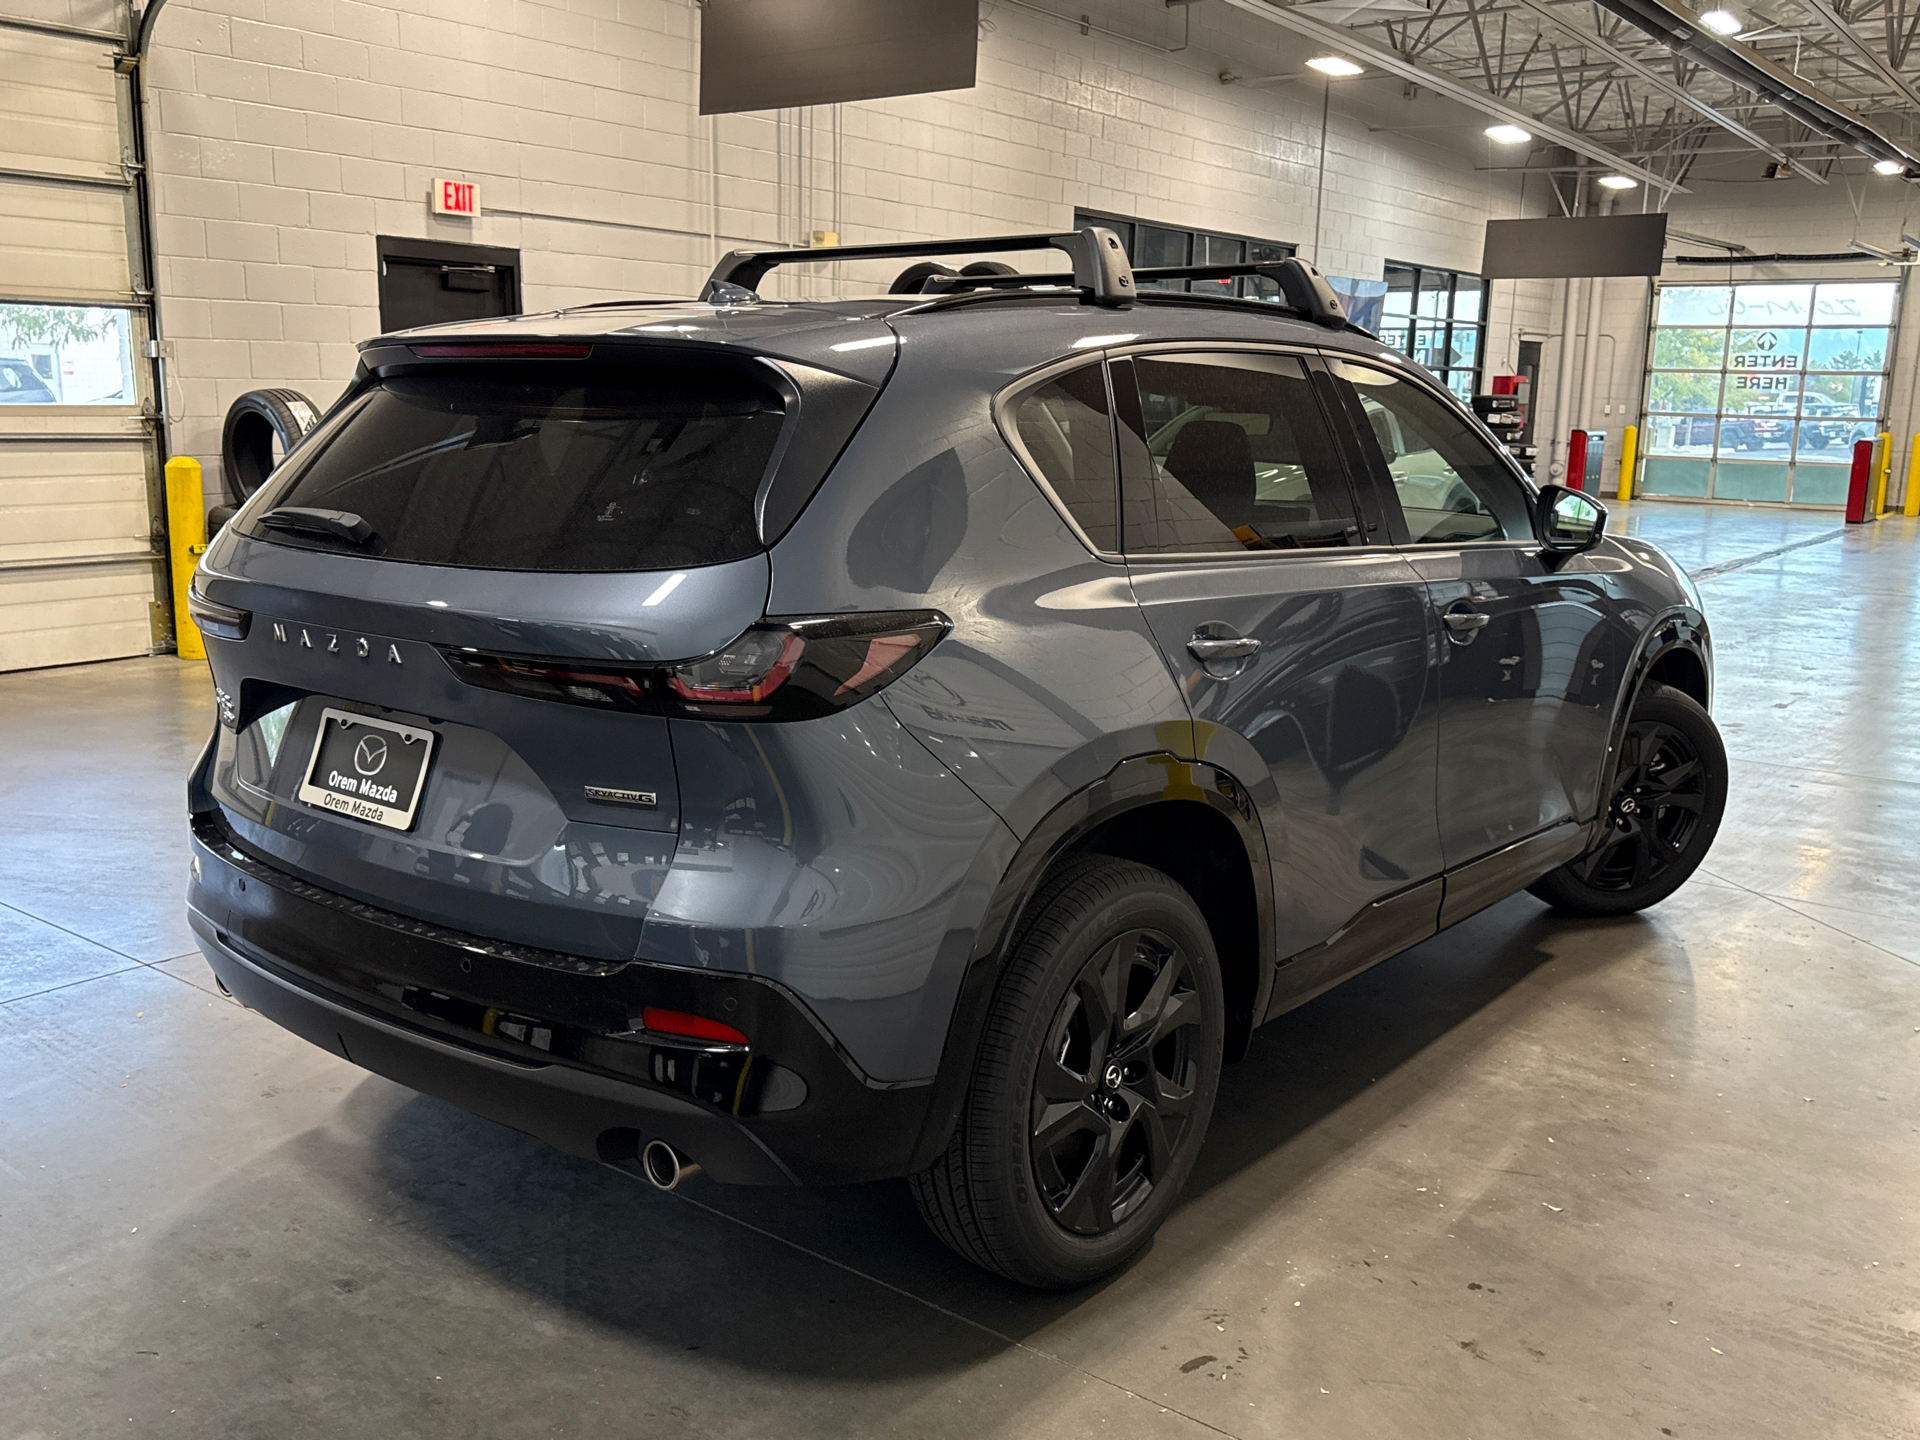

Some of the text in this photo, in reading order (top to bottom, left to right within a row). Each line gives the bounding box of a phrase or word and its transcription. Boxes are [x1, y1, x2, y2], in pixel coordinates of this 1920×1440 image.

[444, 181, 474, 213] EXIT
[273, 622, 402, 664] MAZDA
[328, 770, 398, 803] Orem Mazda
[323, 793, 384, 821] Orem Mazda
